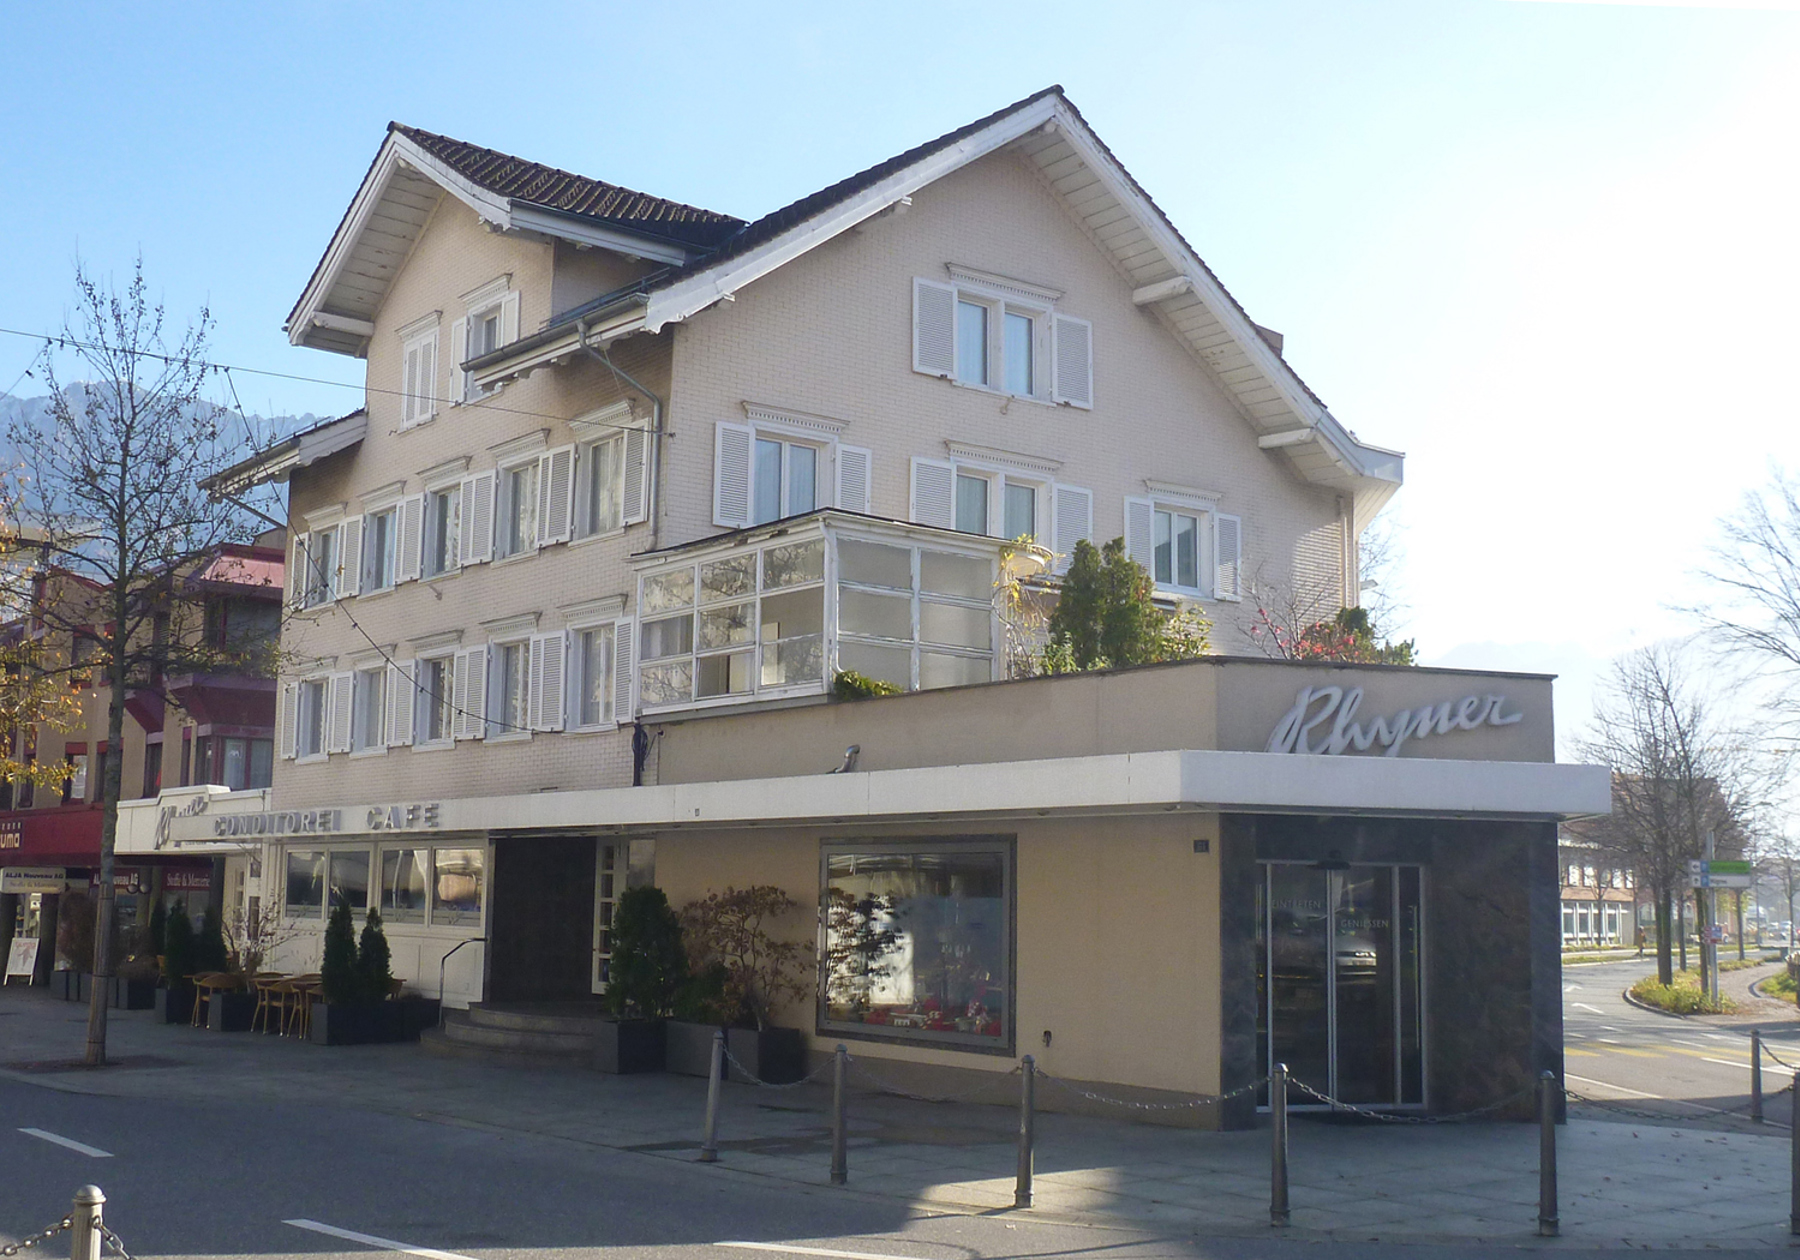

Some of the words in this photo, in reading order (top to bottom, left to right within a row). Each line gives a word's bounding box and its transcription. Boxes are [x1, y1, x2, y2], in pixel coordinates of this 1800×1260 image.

[1265, 685, 1523, 757] Rhyner
[214, 809, 341, 836] CONDITOREI
[367, 803, 440, 830] CAFE
